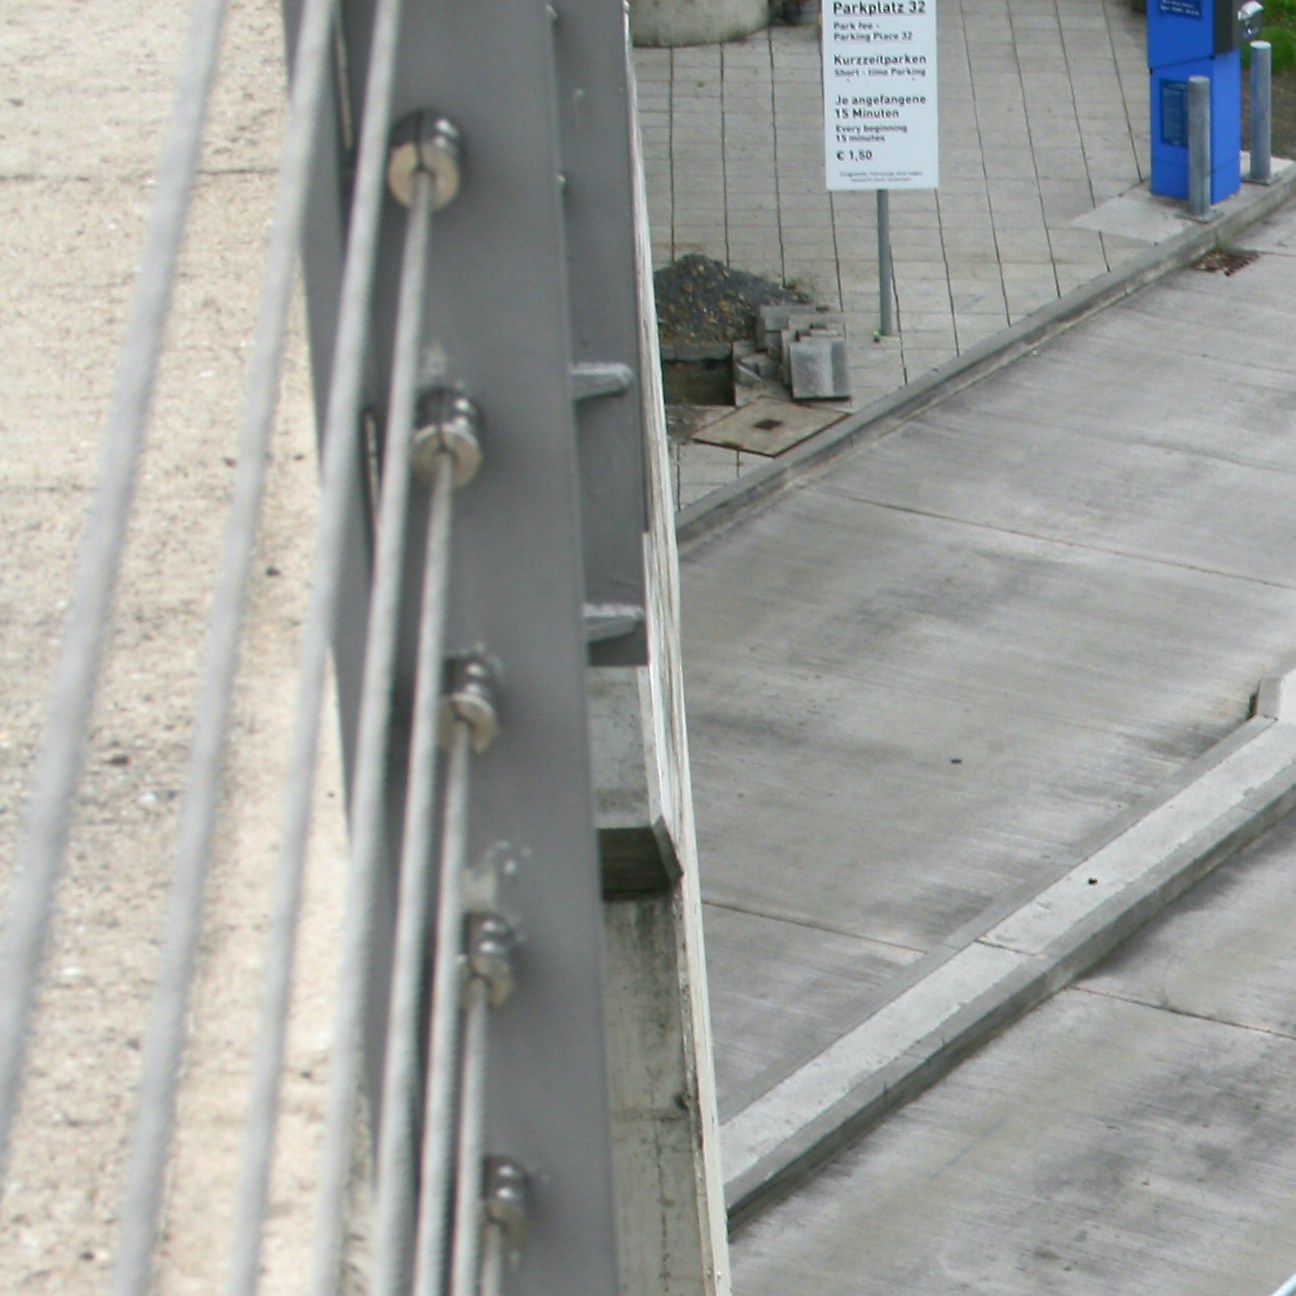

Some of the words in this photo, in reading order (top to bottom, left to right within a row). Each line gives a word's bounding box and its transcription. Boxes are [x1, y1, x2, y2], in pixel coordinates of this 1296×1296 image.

[832, 1, 905, 16] Parkplatz
[908, 1, 927, 14] 32
[833, 21, 857, 30] Park
[858, 21, 873, 30] fee
[833, 32, 872, 43] Parking
[873, 32, 899, 41] Place
[901, 32, 913, 41] 32
[834, 55, 927, 67] Kurzzeitparken
[834, 69, 859, 78] Short
[868, 69, 888, 78] time
[890, 69, 927, 79] Parking
[835, 95, 848, 106] Je
[851, 95, 927, 107] angefangene
[835, 109, 849, 120] 15
[852, 109, 900, 120] Minuten
[835, 125, 861, 135] Every
[863, 124, 908, 135] beginning
[835, 134, 848, 143] 15
[849, 134, 886, 143] minutes
[836, 151, 845, 162] €
[848, 150, 873, 163] 1,50
